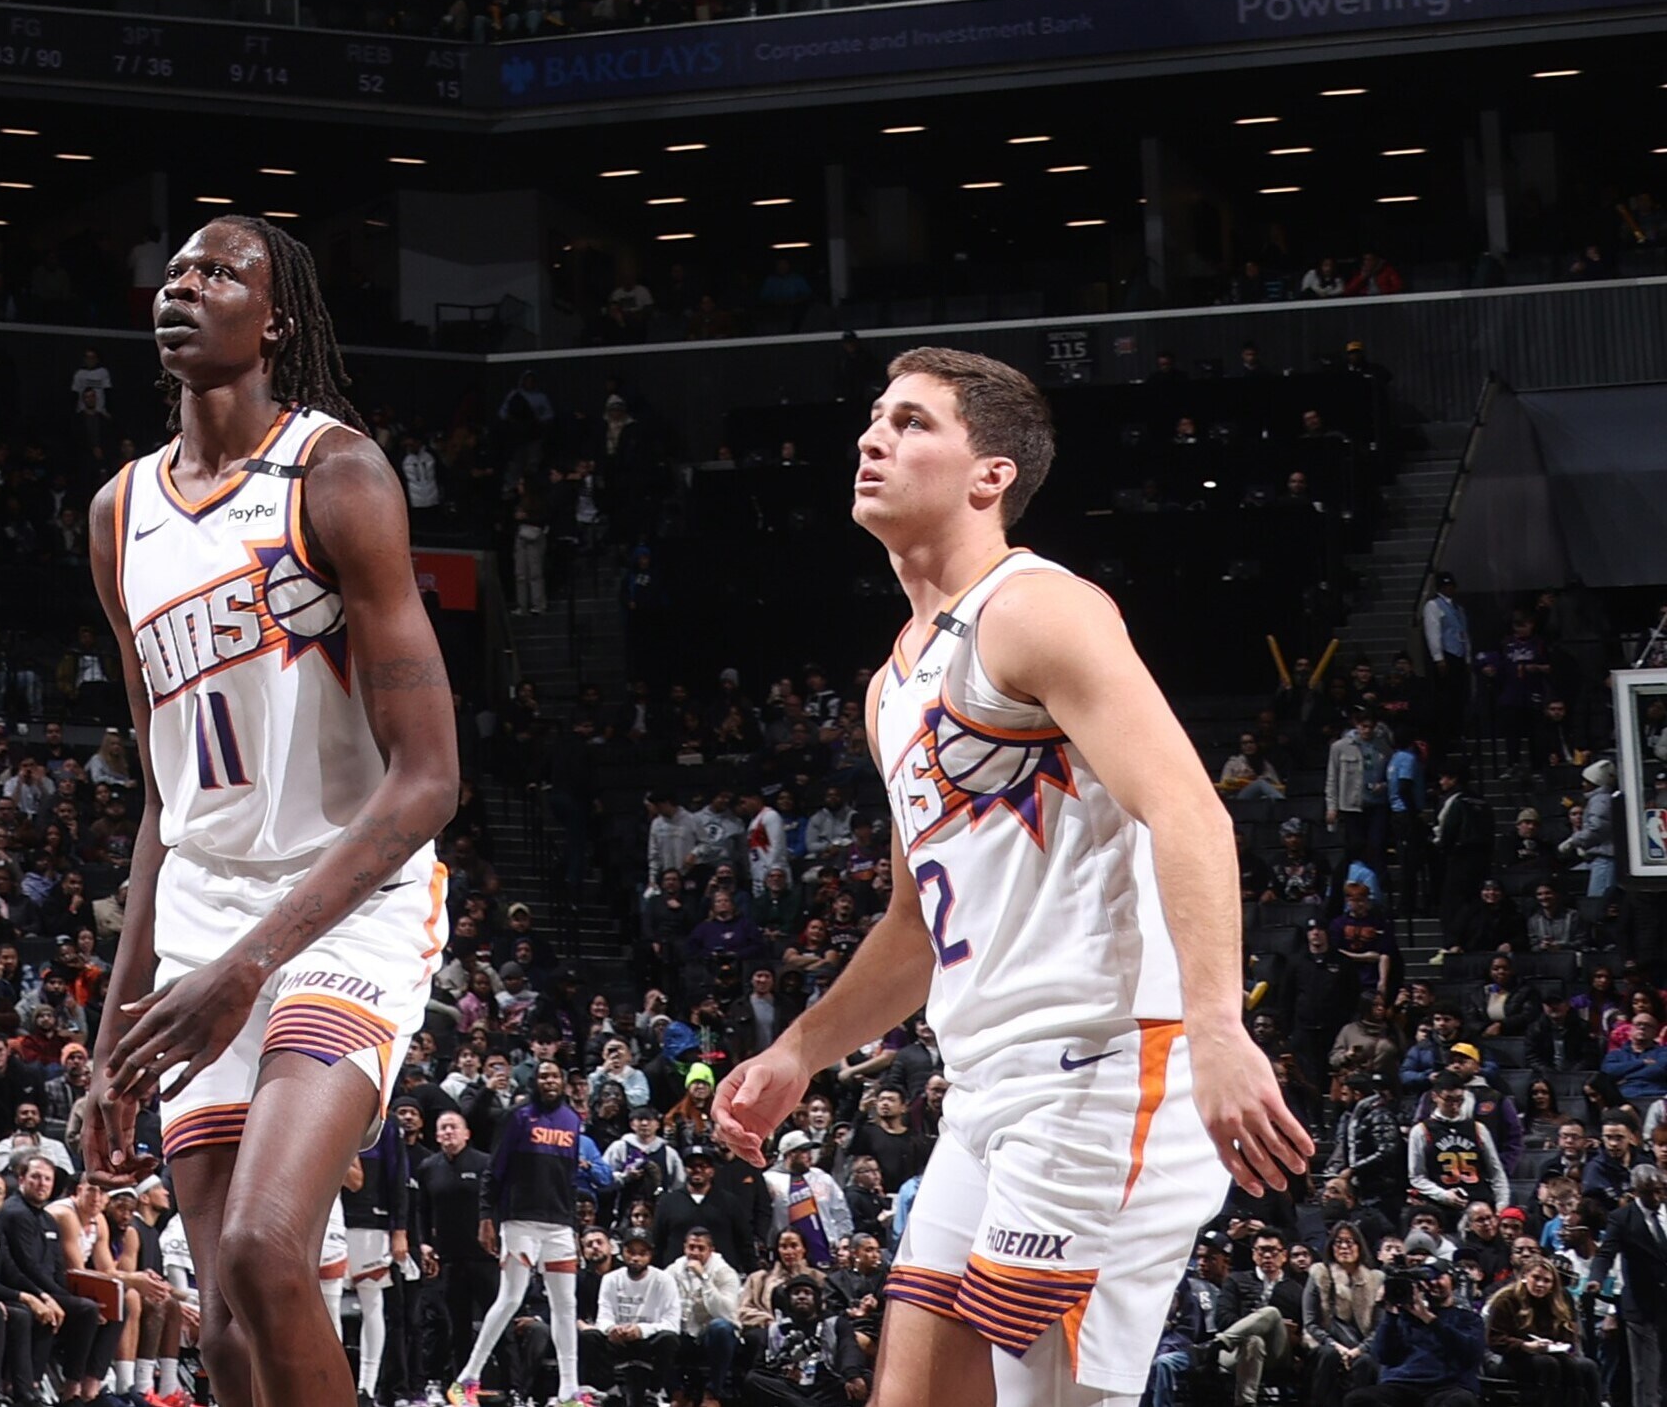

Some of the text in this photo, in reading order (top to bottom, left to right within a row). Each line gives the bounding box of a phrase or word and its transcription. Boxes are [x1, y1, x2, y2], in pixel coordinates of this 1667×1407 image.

[10, 16, 42, 38] FG
[122, 26, 165, 48] 3PT
[245, 35, 272, 54] FT
[347, 43, 392, 67] REB
[545, 14, 1095, 88] BARCLAYS Corporate and Investment Bank
[35, 48, 62, 70] 90
[114, 55, 126, 73] 7
[147, 57, 173, 77] 36
[426, 49, 467, 70] AST
[230, 63, 243, 83] 9
[265, 67, 288, 84] 14
[357, 73, 385, 93] 52
[436, 79, 460, 98] 15
[1049, 342, 1087, 359] 115
[228, 502, 277, 523] PayPal
[196, 691, 254, 790] 11
[530, 1126, 575, 1148] SUNS
[1436, 1150, 1481, 1185] 35
